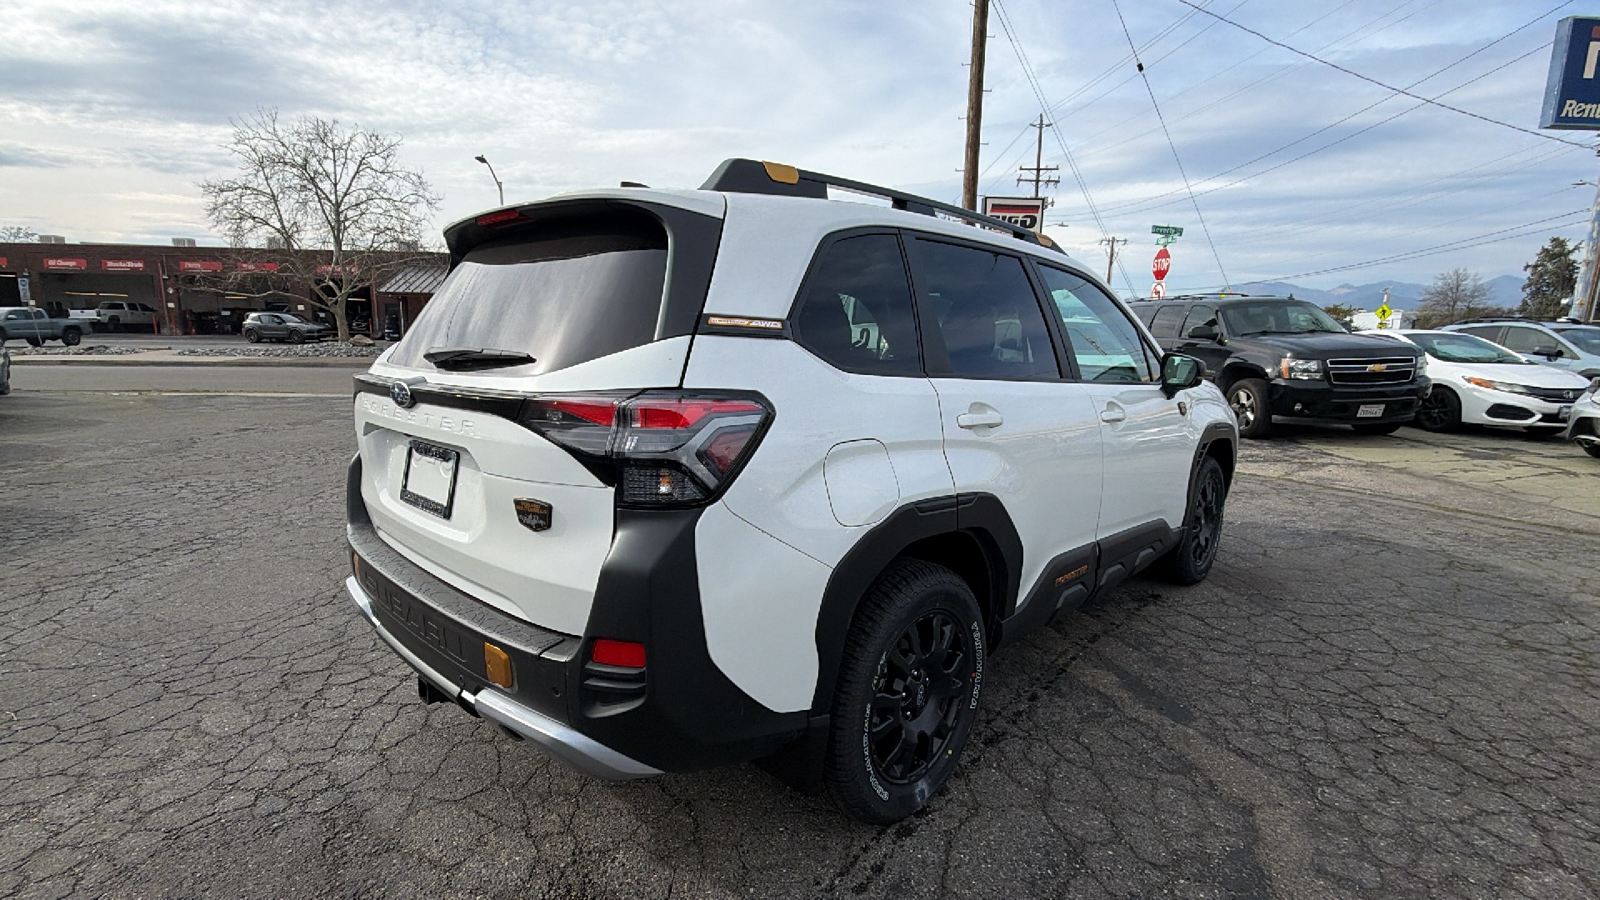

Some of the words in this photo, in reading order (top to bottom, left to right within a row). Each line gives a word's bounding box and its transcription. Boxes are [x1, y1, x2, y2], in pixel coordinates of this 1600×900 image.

[1153, 257, 1170, 272] STOP
[362, 400, 478, 438] FORESTER
[364, 570, 468, 663] SUBARU
[969, 621, 983, 709] YOKOHAMA
